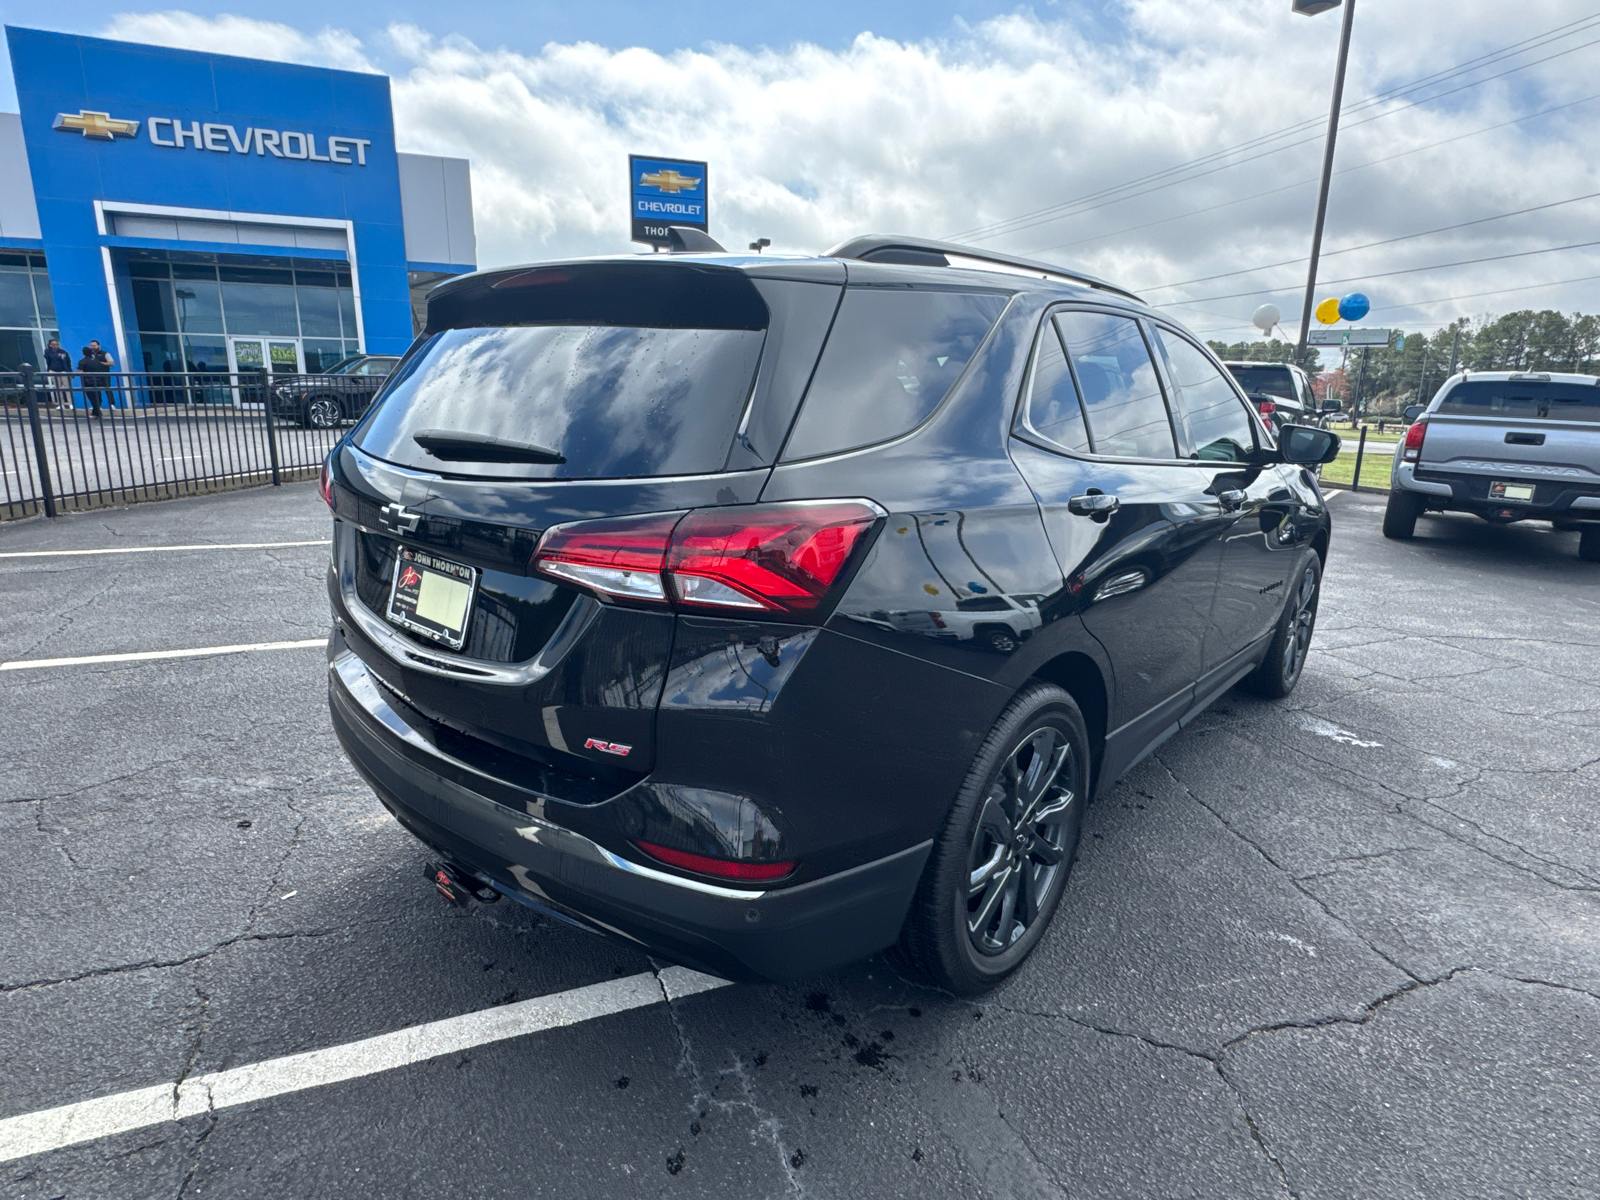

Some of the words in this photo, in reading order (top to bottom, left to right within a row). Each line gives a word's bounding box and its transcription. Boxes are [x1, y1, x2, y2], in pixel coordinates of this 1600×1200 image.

[148, 117, 371, 165] CHEVROLET
[638, 200, 702, 215] CHEVROLET
[1460, 460, 1580, 477] TACOMA
[414, 552, 432, 567] JOHN
[432, 558, 470, 579] THORNTON
[584, 737, 633, 756] RS
